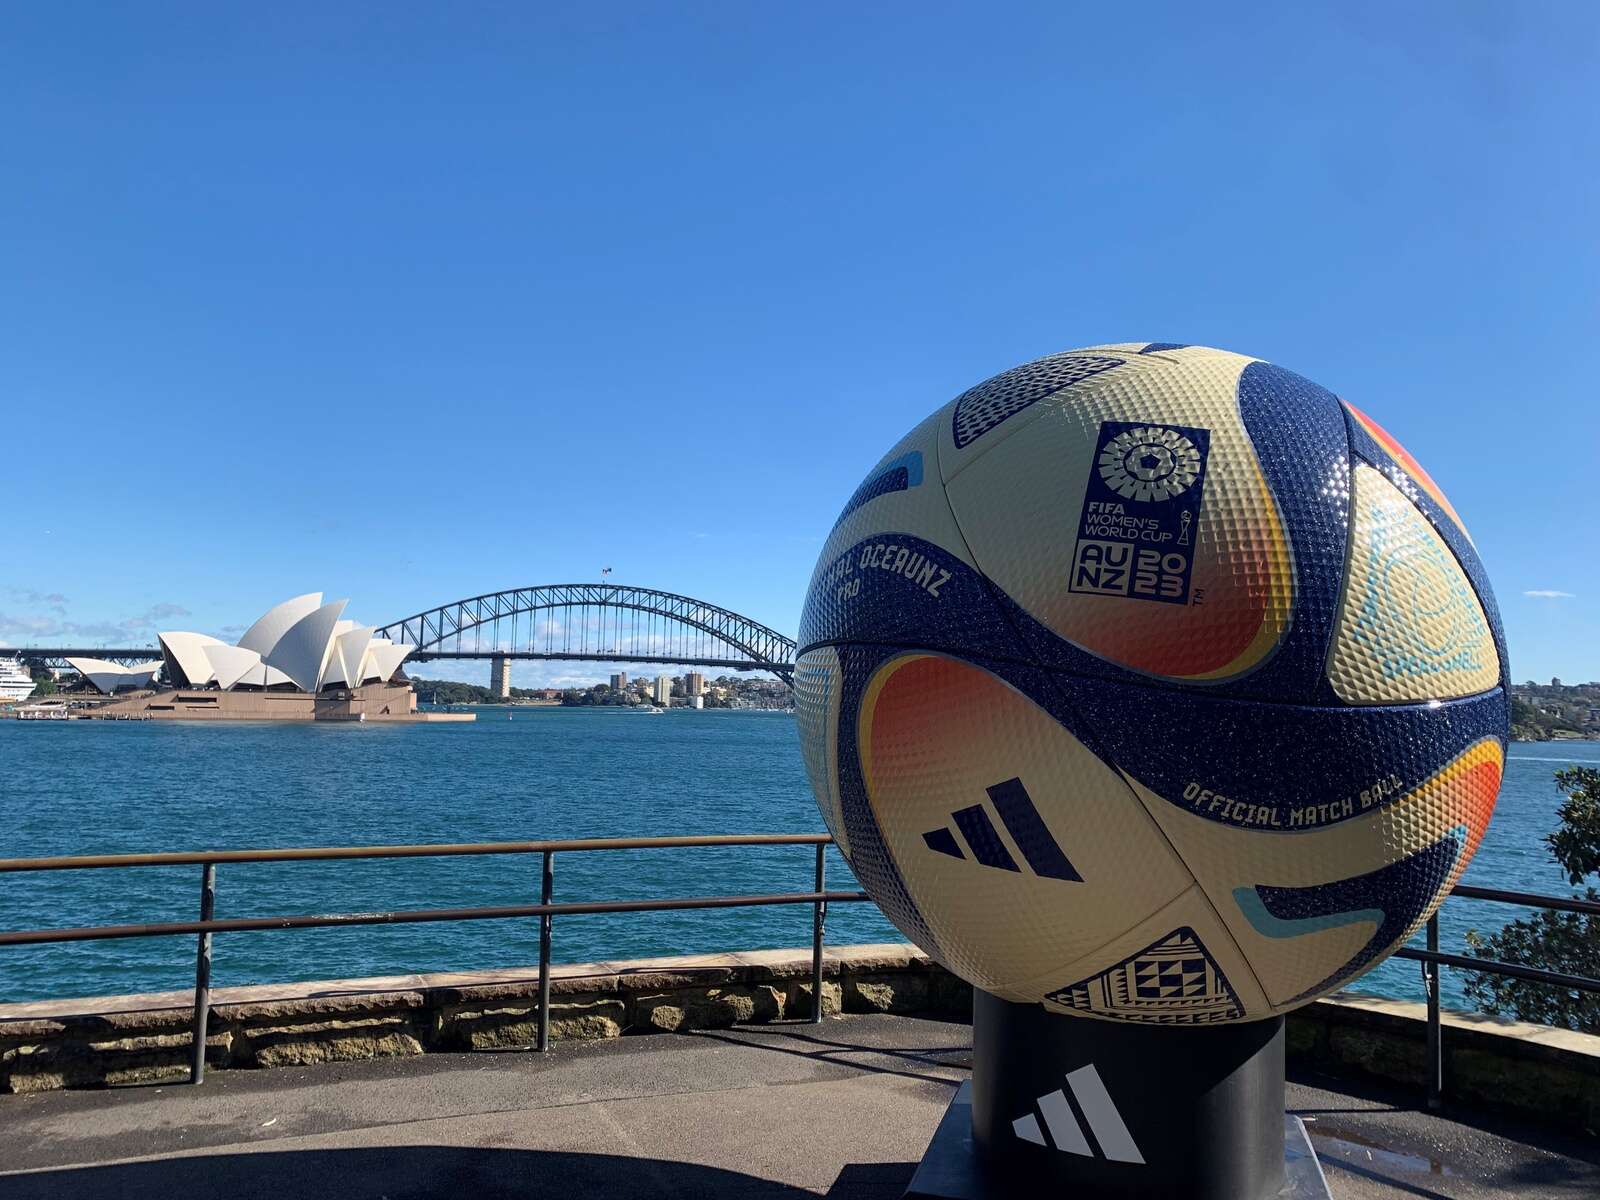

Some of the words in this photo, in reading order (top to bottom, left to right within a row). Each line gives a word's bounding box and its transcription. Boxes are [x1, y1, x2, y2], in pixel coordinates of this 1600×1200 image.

[1088, 501, 1125, 515] FIFA
[1085, 524, 1140, 540] WORLD
[1141, 530, 1174, 543] CUP
[1087, 514, 1160, 530] WOMEN'S
[1079, 543, 1129, 568] AU
[1137, 549, 1188, 576] 20
[859, 544, 953, 598] OCEAUNZ
[1076, 566, 1126, 590] NZ
[836, 578, 861, 606] PRO
[1133, 572, 1184, 598] 23
[1192, 587, 1205, 608] TM
[1182, 781, 1282, 827] OFFICIAL
[1289, 797, 1354, 827] MATCH
[1359, 773, 1404, 808] BALL
